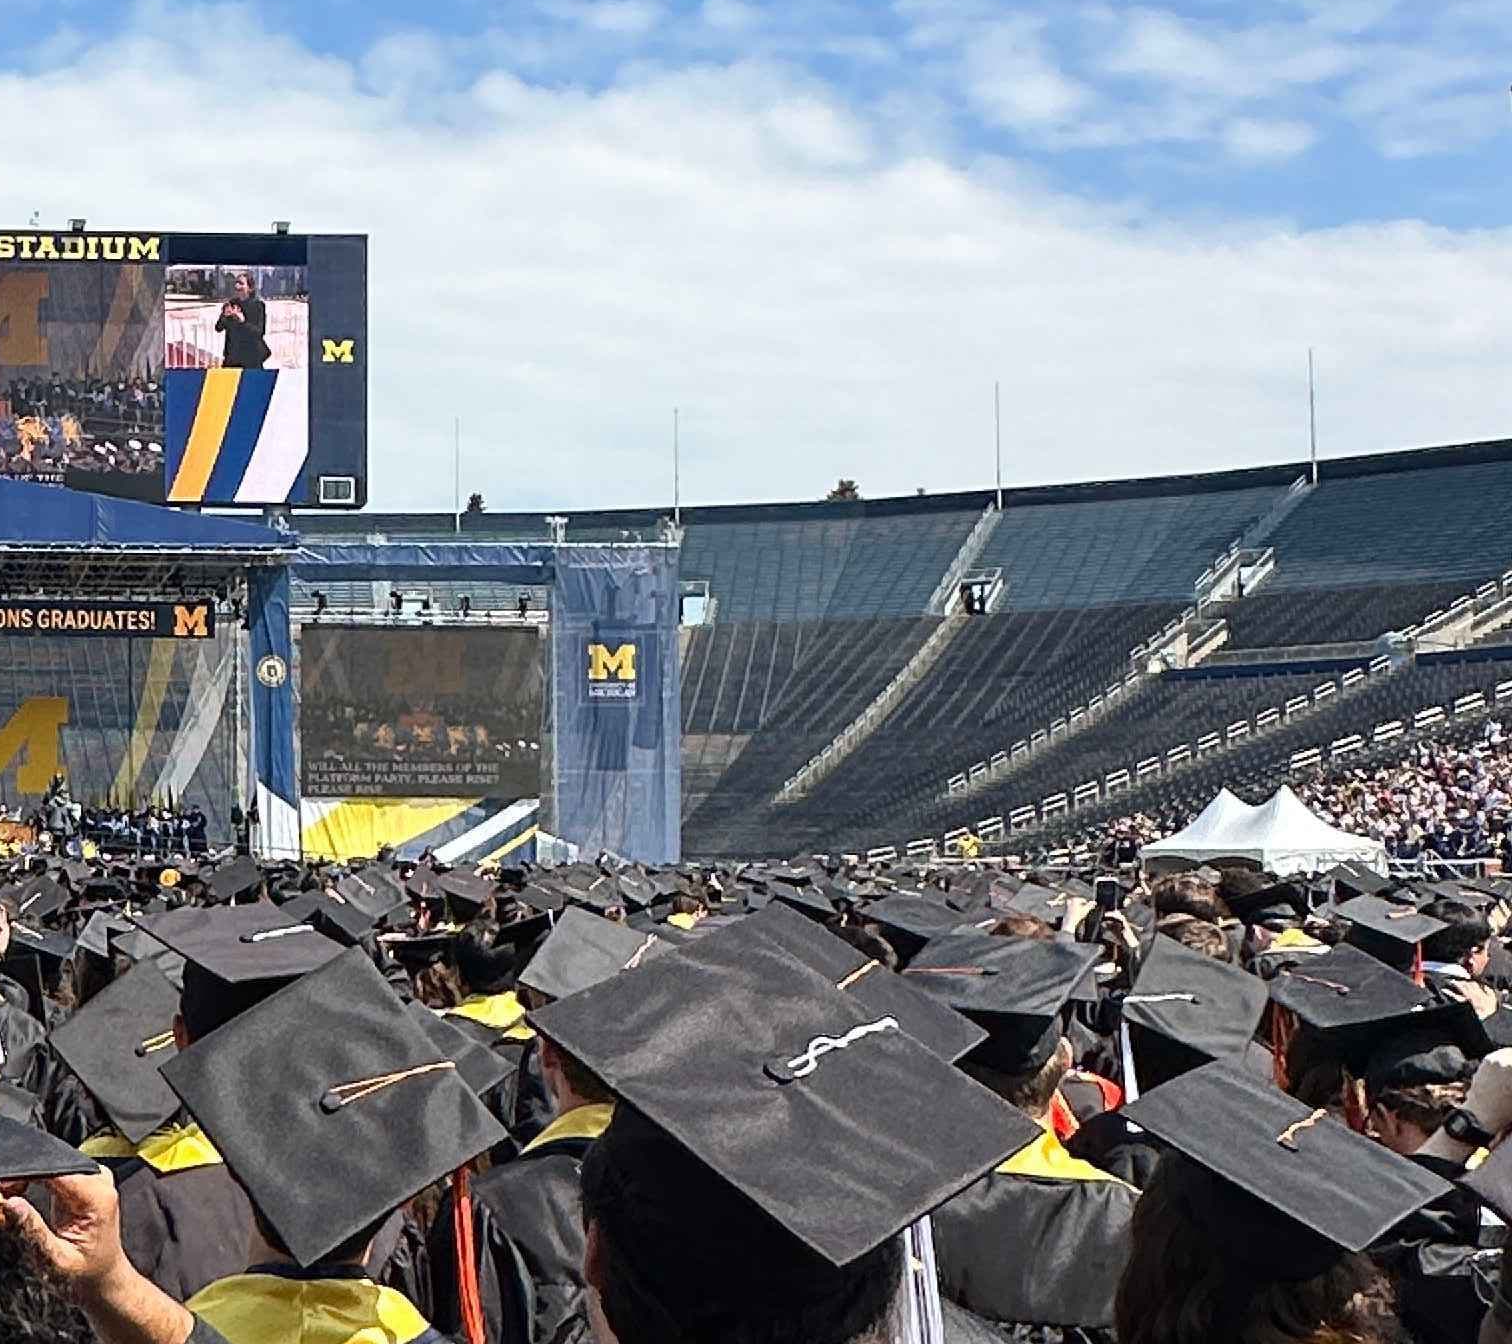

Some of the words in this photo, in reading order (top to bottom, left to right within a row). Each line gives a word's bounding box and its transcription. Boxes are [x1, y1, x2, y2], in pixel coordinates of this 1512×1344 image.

[321, 339, 355, 363] M
[37, 474, 65, 482] THE
[37, 608, 157, 630] GRADUATES!
[173, 606, 209, 636] M
[588, 643, 636, 680] M
[364, 762, 389, 772] THE
[476, 763, 500, 773] THE
